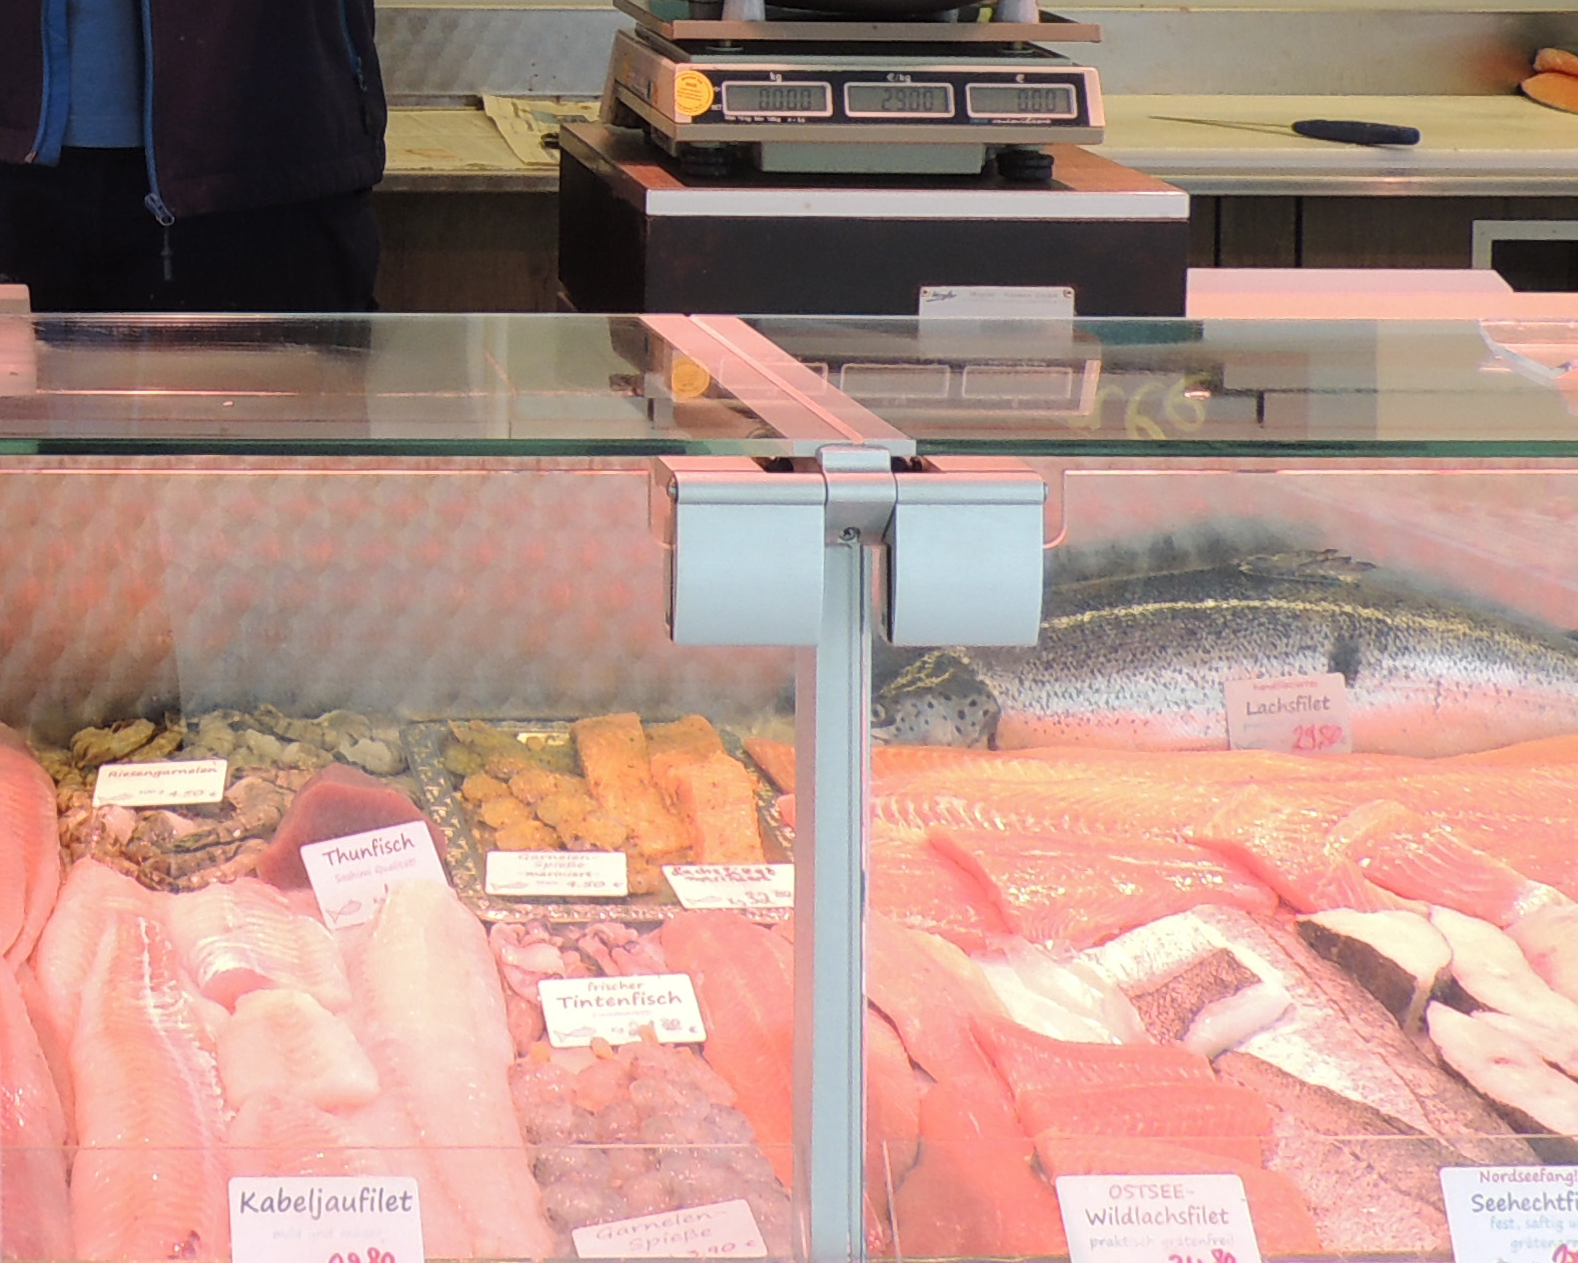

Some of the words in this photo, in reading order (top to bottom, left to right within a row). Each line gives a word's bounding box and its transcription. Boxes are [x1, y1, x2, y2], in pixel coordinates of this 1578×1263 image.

[770, 72, 782, 82] kg
[1246, 695, 1331, 716] Lachsfilet
[108, 767, 217, 778] Riesengarnelen
[322, 833, 415, 866] Thunfisch
[587, 981, 644, 992] frischer
[556, 991, 682, 1009] Tintenfisch
[1108, 1184, 1195, 1199] OSTSEE-
[240, 1187, 413, 1220] Kabeljaufilet
[1085, 1205, 1229, 1226] Wildlachsfilet
[629, 1228, 712, 1251] Spieße
